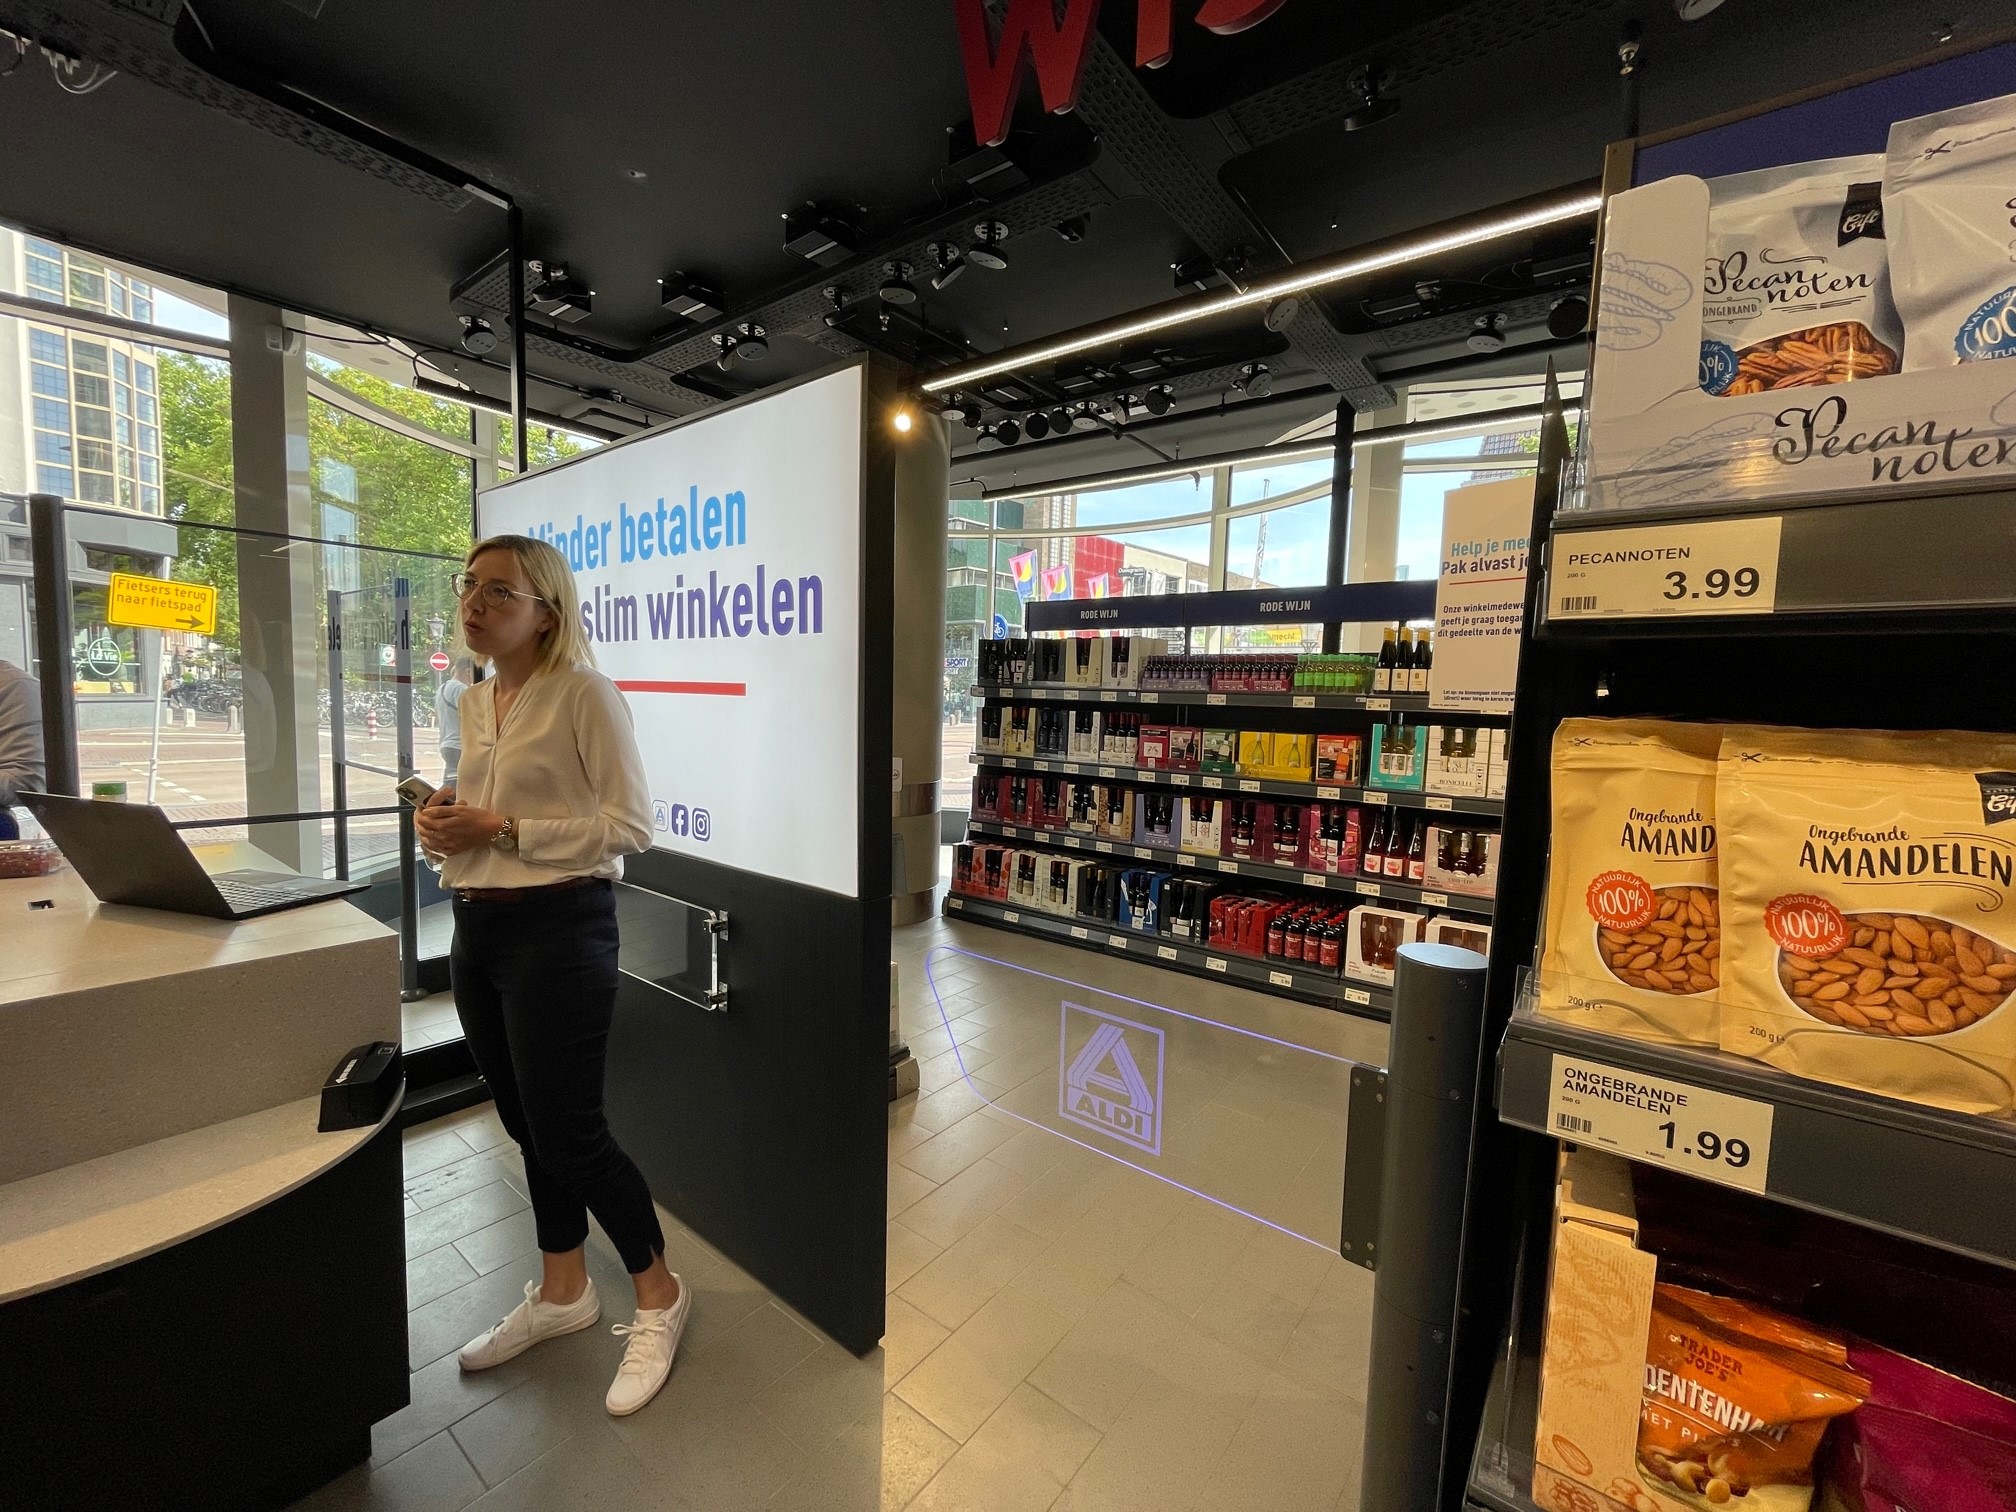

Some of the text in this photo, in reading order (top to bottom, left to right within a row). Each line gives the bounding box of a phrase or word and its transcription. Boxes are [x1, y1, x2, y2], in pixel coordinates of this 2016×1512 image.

[1704, 250, 1804, 295] Pecan
[1767, 272, 1877, 304] noten
[1772, 395, 1937, 465] Pecan
[620, 484, 746, 564] betalen
[1451, 541, 1483, 558] Help
[1485, 539, 1499, 556] je
[1568, 547, 1691, 565] PECANNOTEN
[1441, 560, 1467, 576] Pak
[1470, 555, 1515, 572] alvast
[117, 579, 207, 603] Fietsers terug
[1663, 567, 1760, 600] 3.99
[116, 594, 202, 613] naar fietspad
[580, 564, 823, 643] slim winkelen
[1081, 609, 1118, 619] RODE WIJN
[1260, 600, 1311, 612] RODE WIJN
[1443, 605, 1461, 614] Onze
[1441, 616, 1461, 627] geeft
[1462, 616, 1470, 626] je
[1471, 615, 1495, 626] graag
[1438, 629, 1448, 638] dit
[1449, 629, 1483, 639] gedeelte
[1485, 628, 1500, 636] van
[1502, 627, 1512, 635] de
[104, 651, 118, 660] Vie
[1629, 808, 1704, 827] Ongebrande
[1621, 822, 1716, 857] AMAND
[1809, 824, 1910, 846] Ongebrande
[1799, 840, 2013, 888] AMANDELEN
[1592, 873, 1642, 894] NATUURLIJK
[1598, 887, 1644, 916] 100%
[1771, 896, 1830, 916] NATUURLIJK
[1598, 909, 1651, 929] NATUURLIJK
[1781, 911, 1836, 939] 100%
[1780, 935, 1846, 954] NATUURLIJK
[1568, 995, 1591, 1011] 200 g
[1749, 1025, 1775, 1043] 200 g
[1563, 1079, 1671, 1116] AMANDELEN
[1564, 1067, 1688, 1107] ONGEBRANDE
[1075, 1093, 1144, 1136] ALDI
[1658, 1121, 1751, 1168] 1.99
[1679, 1333, 1743, 1376] TRADER
[1685, 1353, 1730, 1382] JOE'S
